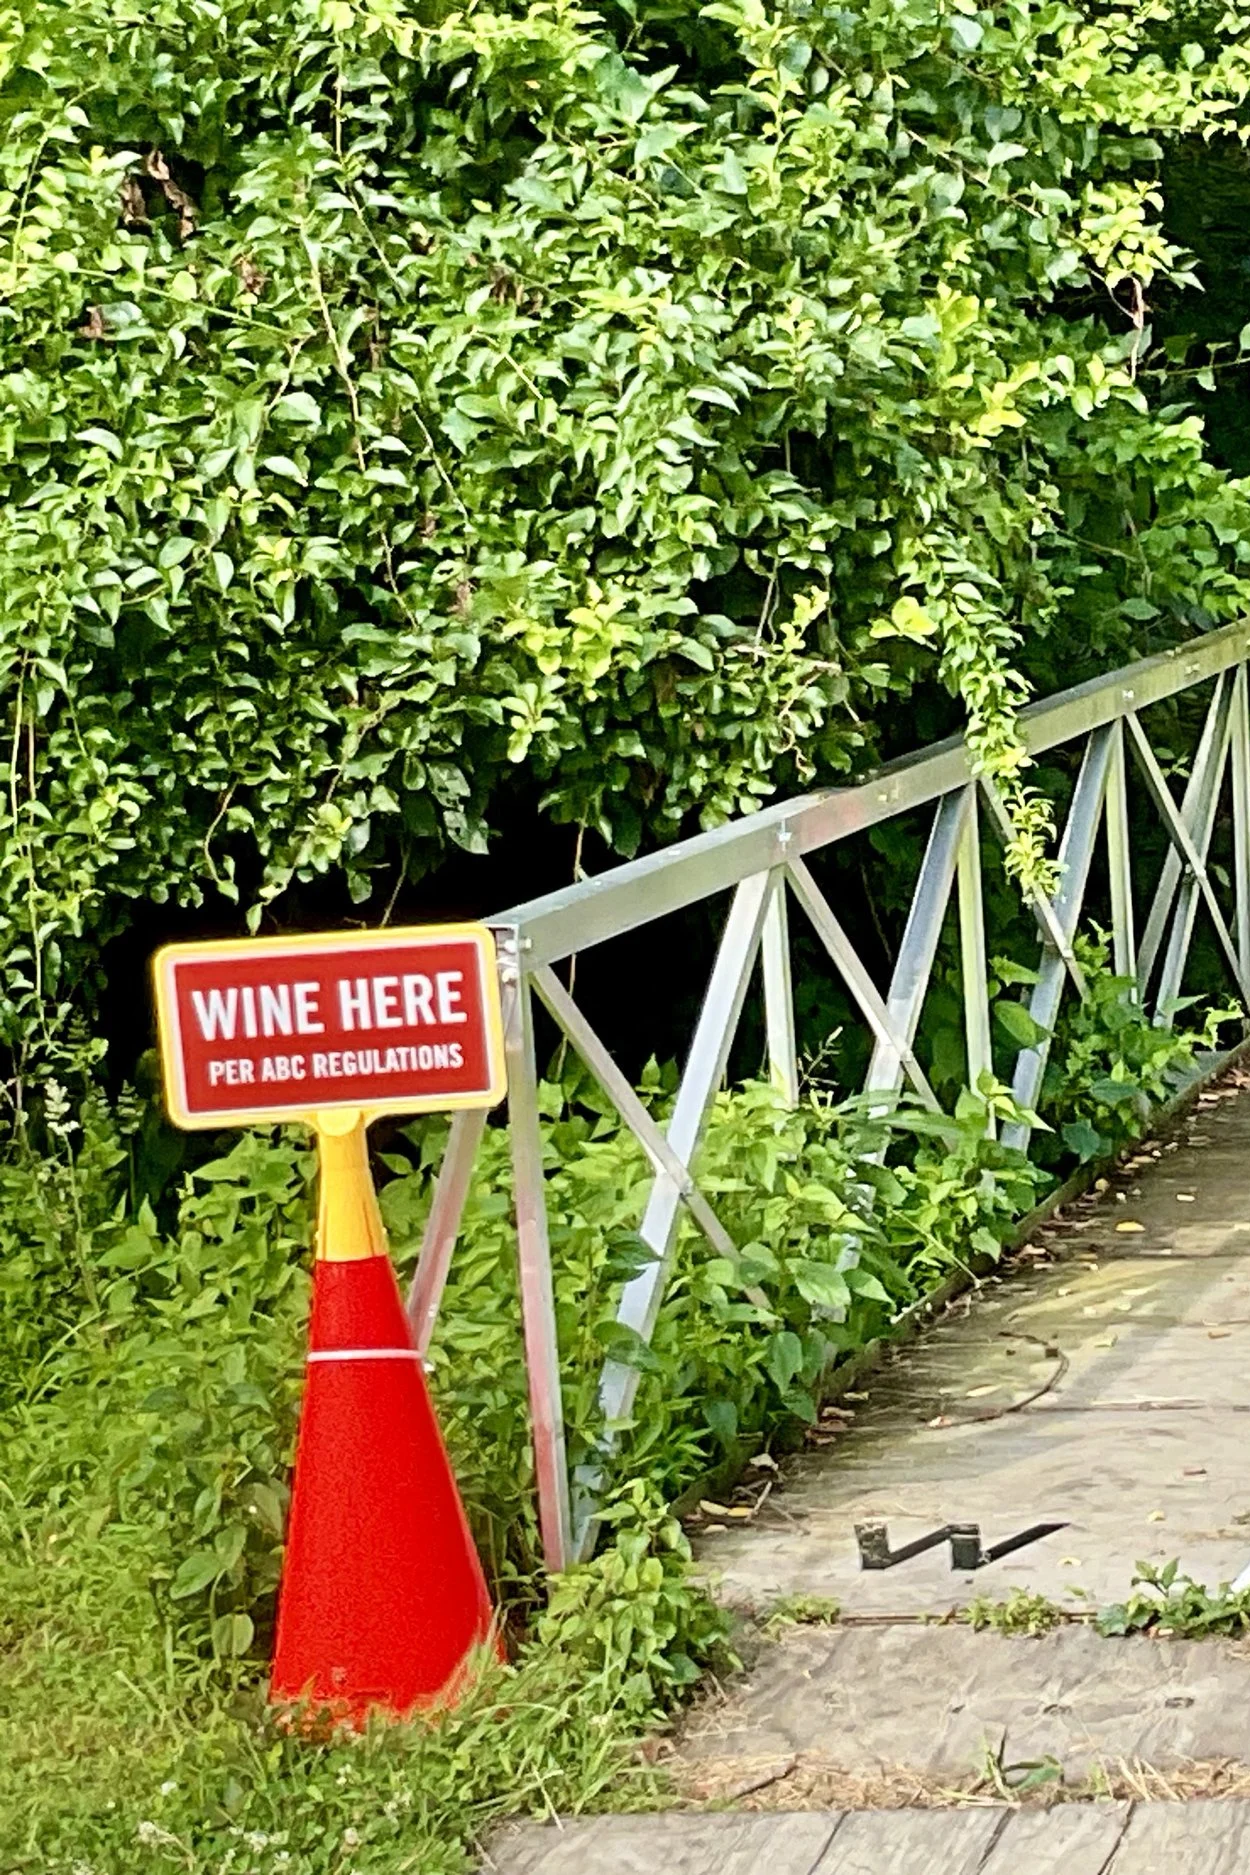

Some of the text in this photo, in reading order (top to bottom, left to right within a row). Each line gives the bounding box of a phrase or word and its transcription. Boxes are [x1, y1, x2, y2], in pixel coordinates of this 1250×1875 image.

[191, 970, 468, 1041] WINE HERE
[208, 1043, 464, 1087] PER ABC REGULATIONS
[854, 1522, 1071, 1570] W
